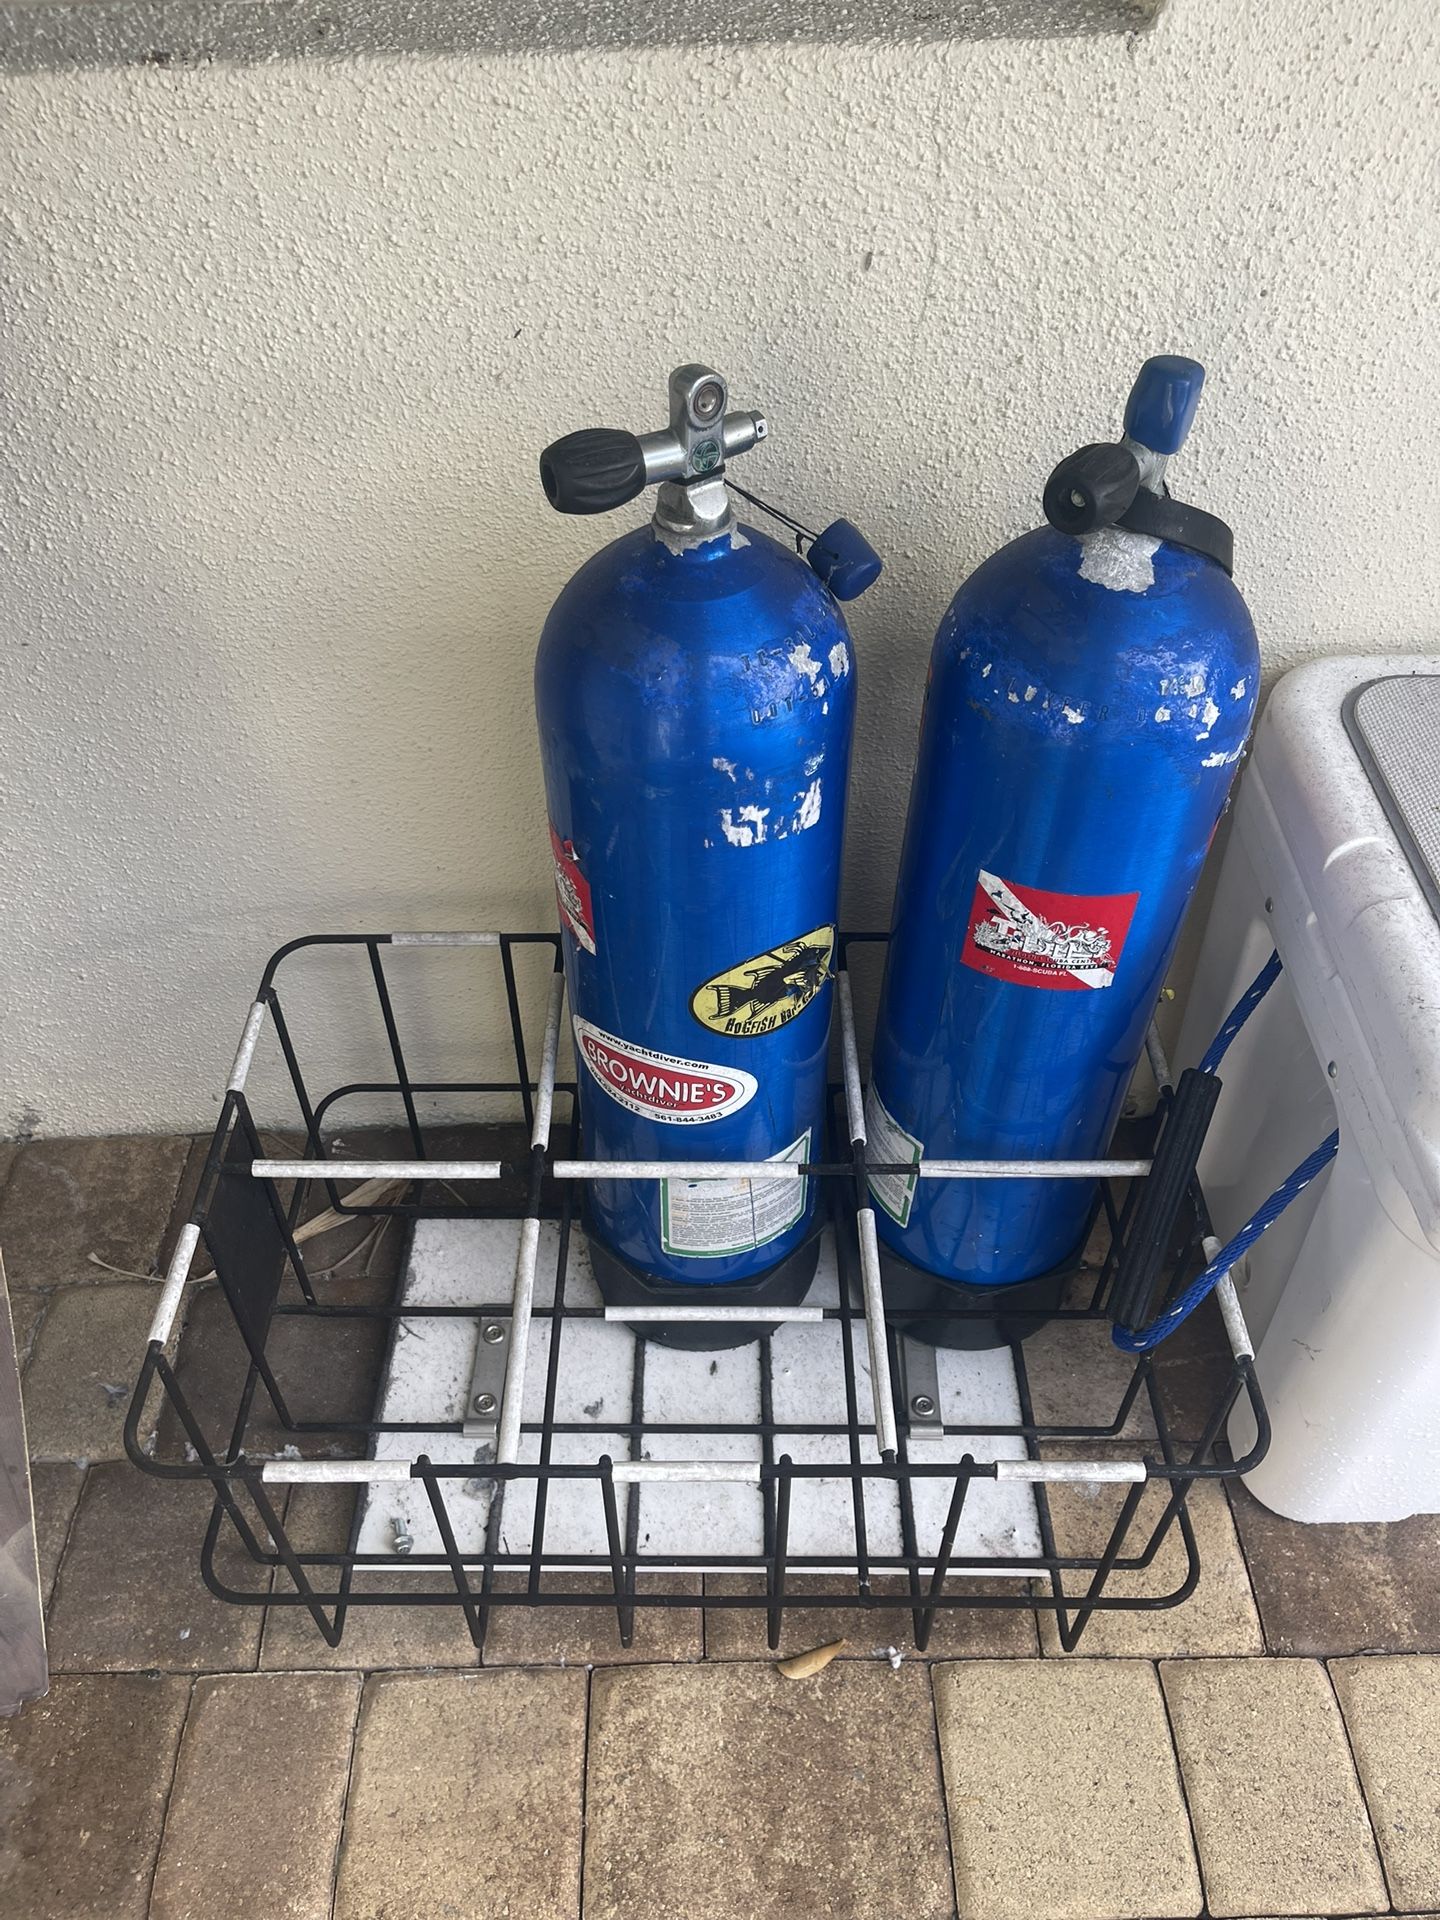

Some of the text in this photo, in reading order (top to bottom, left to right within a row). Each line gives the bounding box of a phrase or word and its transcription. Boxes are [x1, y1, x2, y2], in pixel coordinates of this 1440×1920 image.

[990, 949, 1038, 967] MARATHON,
[1041, 962, 1076, 970] FLORIDA
[599, 1031, 709, 1070] www.yachtdiver.com
[587, 1040, 727, 1104] BROWNIE'S
[654, 1112, 723, 1123] 561-844-3483
